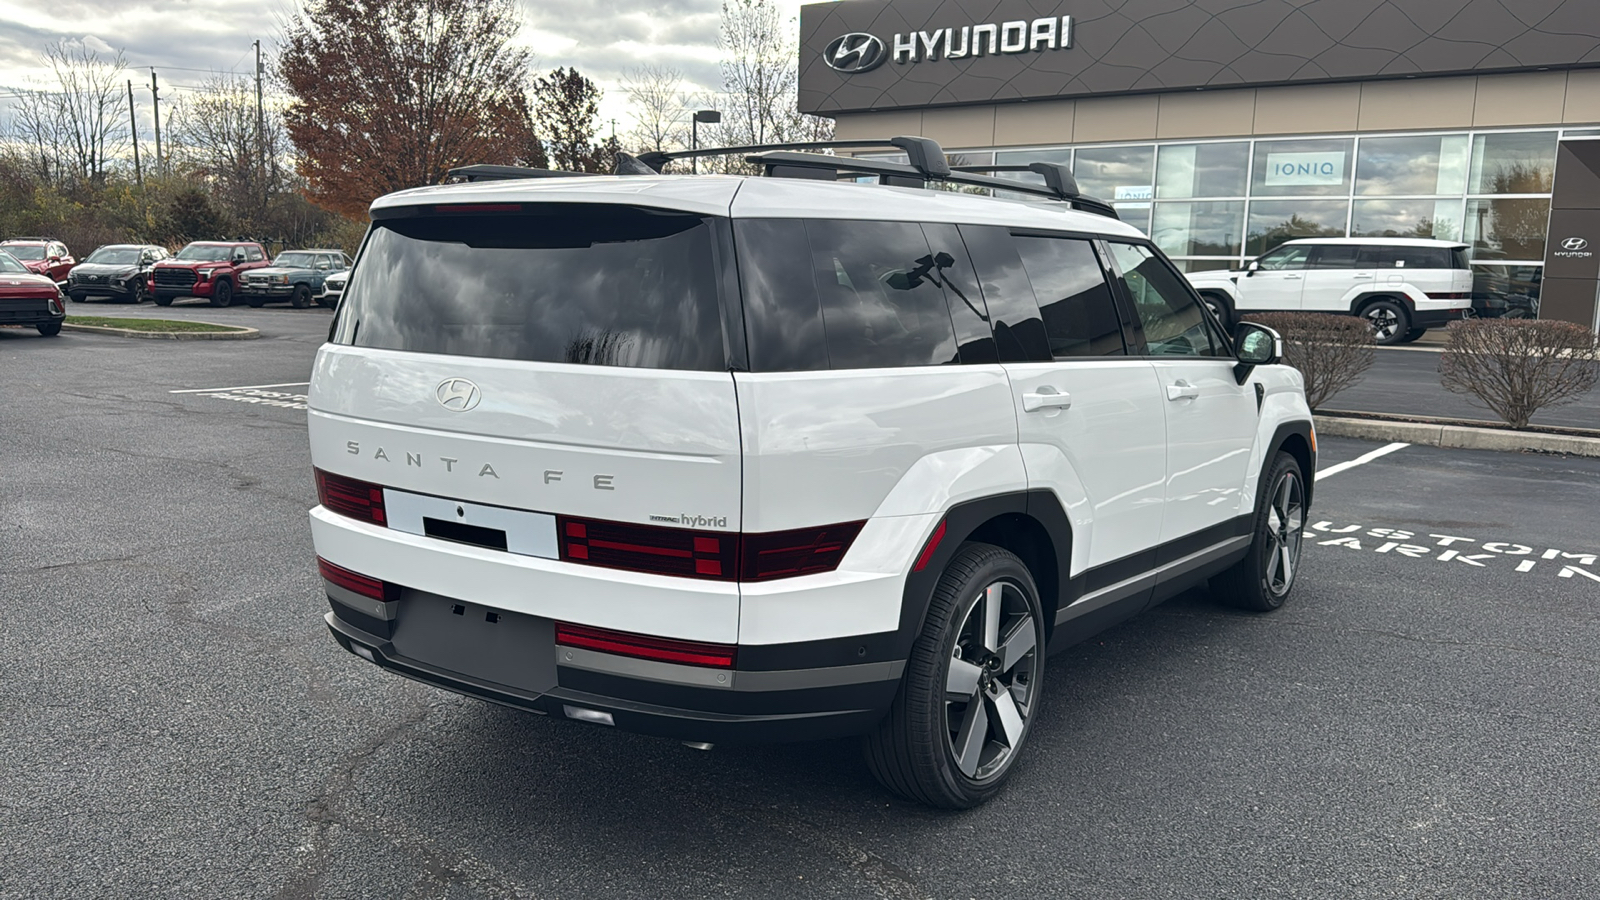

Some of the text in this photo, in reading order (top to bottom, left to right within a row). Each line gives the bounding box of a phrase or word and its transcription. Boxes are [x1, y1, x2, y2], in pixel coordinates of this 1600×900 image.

[893, 15, 1072, 63] HYUNDAI
[1275, 162, 1334, 176] IONIQ
[346, 440, 616, 491] SANTA FE
[680, 512, 727, 528] hybrid
[1311, 520, 1599, 565] USTOM
[1302, 530, 1600, 582] ARKIN
